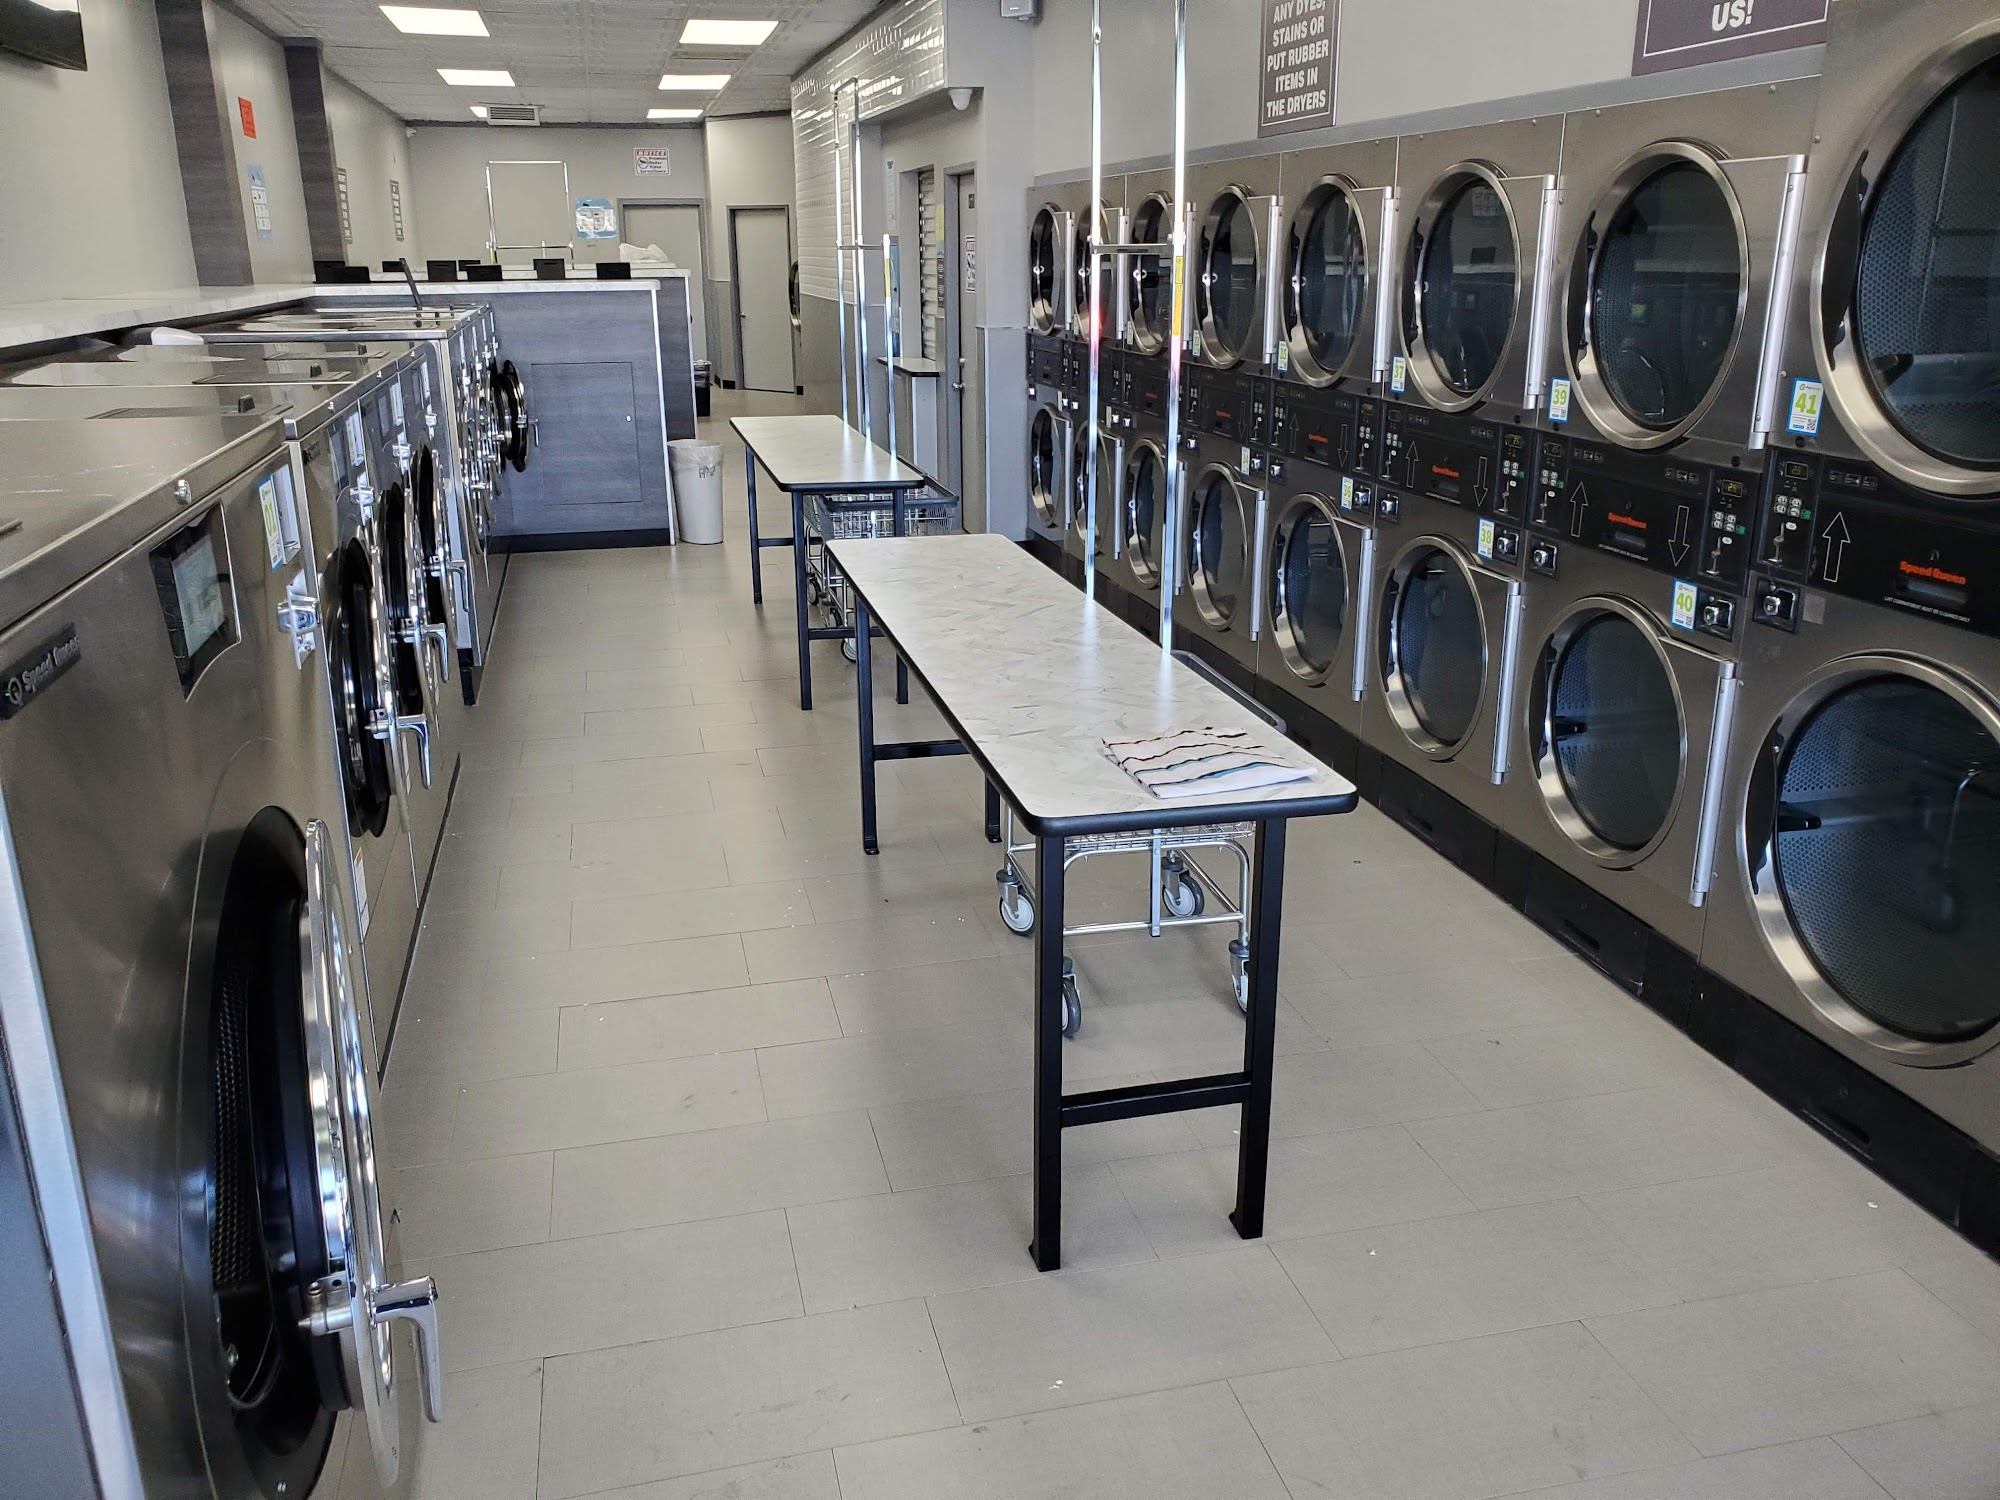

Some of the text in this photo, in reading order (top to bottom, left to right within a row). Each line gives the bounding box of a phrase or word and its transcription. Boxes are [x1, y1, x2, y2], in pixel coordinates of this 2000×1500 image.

[1273, 0, 1294, 23] ANY
[1712, 0, 1753, 32] US!
[1272, 15, 1325, 47] STAINS OR
[1267, 39, 1329, 72] PUT RUBBER
[1275, 66, 1318, 93] ITEMS IN
[1266, 89, 1327, 118] THE DRYERS
[1393, 364, 1404, 379] 37
[1552, 388, 1567, 406] 39
[1794, 392, 1817, 415] 41
[1727, 482, 1737, 493] 25
[1480, 527, 1493, 545] 38
[1900, 560, 1967, 585] Speed Queen
[1675, 592, 1693, 613] 40
